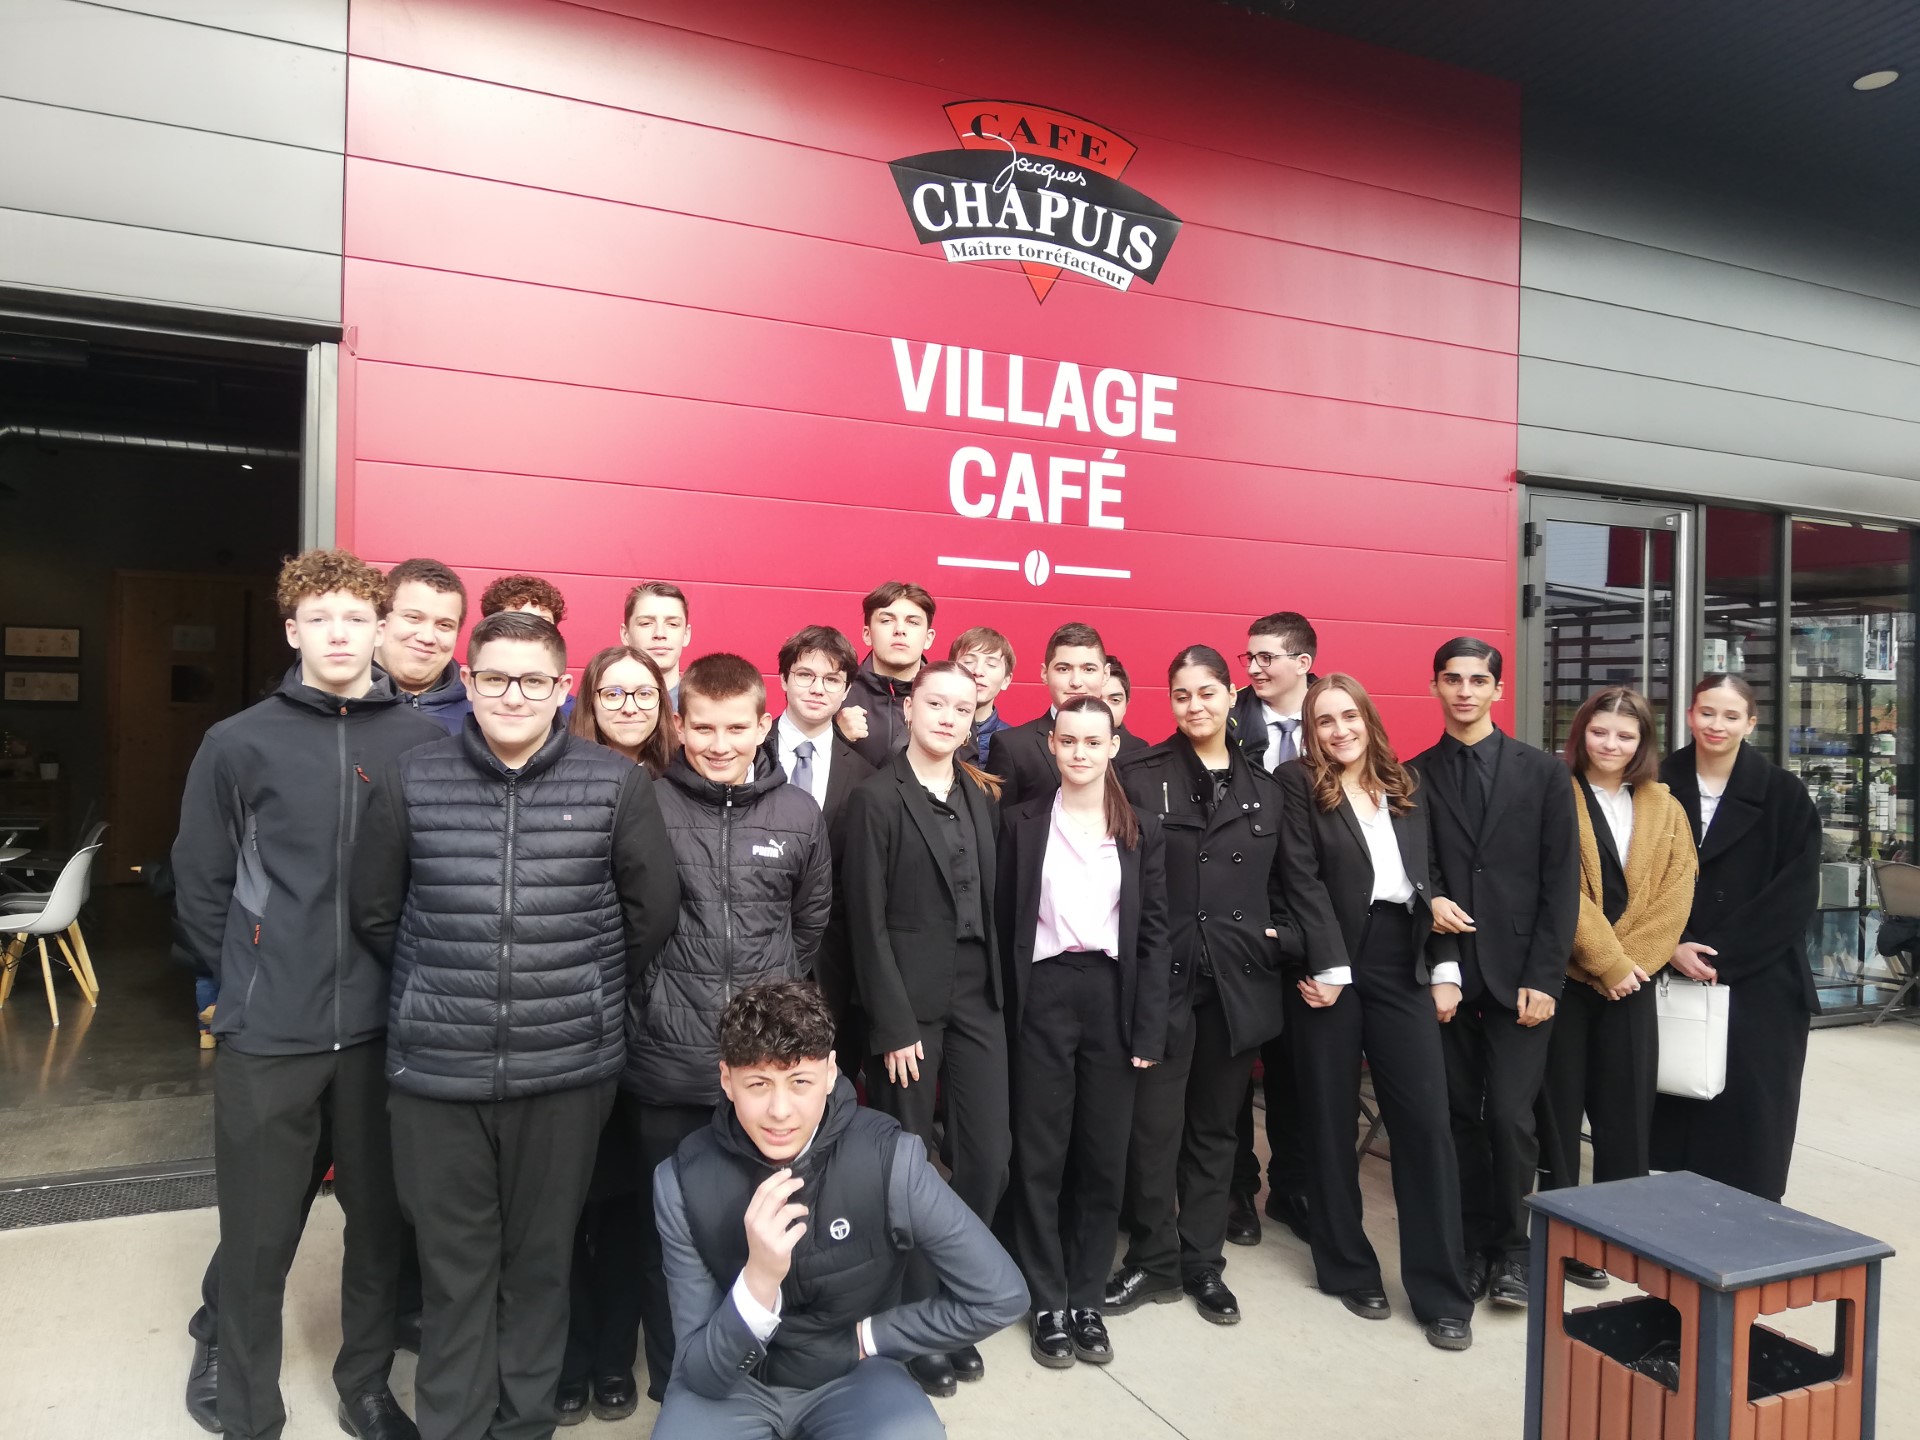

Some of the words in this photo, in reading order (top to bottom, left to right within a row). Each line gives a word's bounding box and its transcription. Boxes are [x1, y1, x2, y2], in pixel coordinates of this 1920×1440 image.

[962, 132, 1087, 193] Jacques
[970, 113, 1108, 166] CAFE
[912, 182, 1158, 271] CHAPUIS
[950, 240, 1012, 258] Maître
[1018, 243, 1126, 287] torréfacteur
[891, 337, 1178, 443] VILLAGE
[949, 446, 1126, 530] CAFÉ
